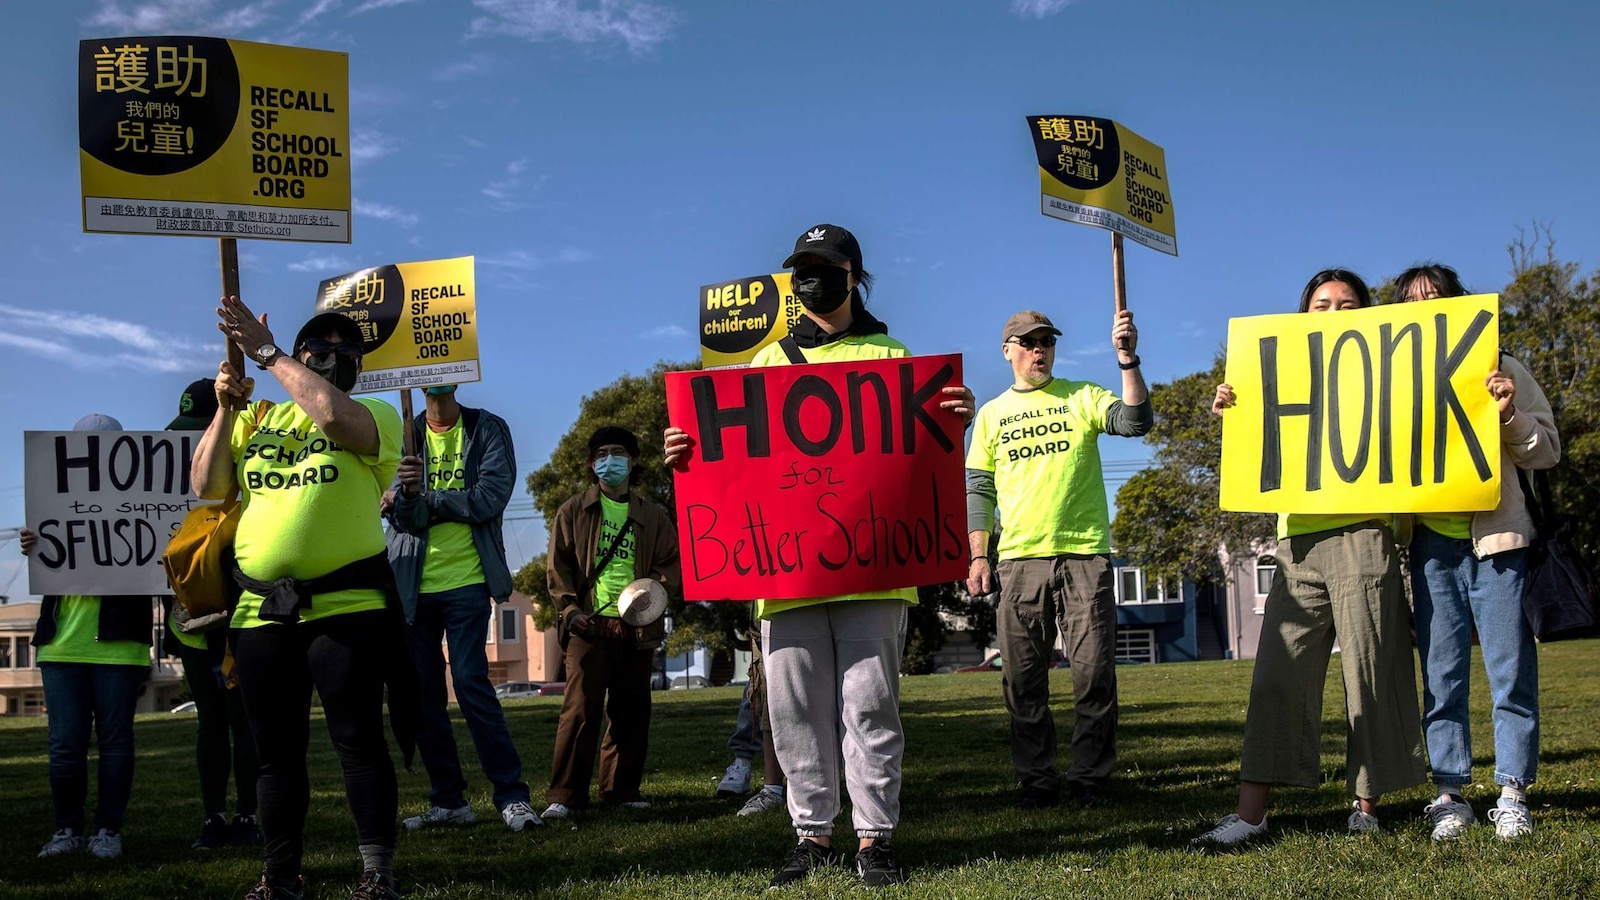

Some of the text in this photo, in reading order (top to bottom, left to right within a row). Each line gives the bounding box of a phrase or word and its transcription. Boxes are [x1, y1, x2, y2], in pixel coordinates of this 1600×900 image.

[94, 44, 207, 98] 護助
[125, 100, 180, 120] 我們的
[251, 85, 335, 113] RECALL
[251, 108, 279, 130] SF
[114, 120, 194, 155] 兒童!
[251, 132, 342, 157] SCHOOL
[1037, 118, 1104, 150] 護助
[1061, 144, 1091, 159] 我們的
[252, 154, 329, 178] BOARD
[1123, 150, 1162, 180] RECALL
[1124, 166, 1136, 179] SF
[253, 177, 305, 199] .ORG
[1125, 178, 1169, 205] SCHOOL
[1126, 189, 1164, 215] BOARD
[1127, 206, 1153, 224] .ORG
[323, 272, 385, 311] 護助
[411, 284, 465, 302] RECALL
[706, 280, 765, 311] HELP
[411, 302, 429, 316] SF
[728, 308, 742, 316] our
[785, 306, 801, 317] SF
[357, 321, 379, 342] 童!
[412, 312, 471, 330] SCHOOL
[703, 313, 768, 336] children!
[414, 327, 463, 345] BOARD
[416, 344, 449, 360] .ORG
[999, 405, 1070, 427] RECALL THE
[1001, 420, 1073, 444] SCHOOL
[243, 438, 343, 466] SCHOOL
[1008, 440, 1070, 462] BOARD
[247, 464, 339, 489] BOARD
[778, 461, 846, 489] for
[69, 501, 102, 514] to
[116, 499, 197, 520] support
[816, 472, 963, 571] Schools
[38, 518, 157, 570] SFUSD
[686, 501, 808, 582] Better
